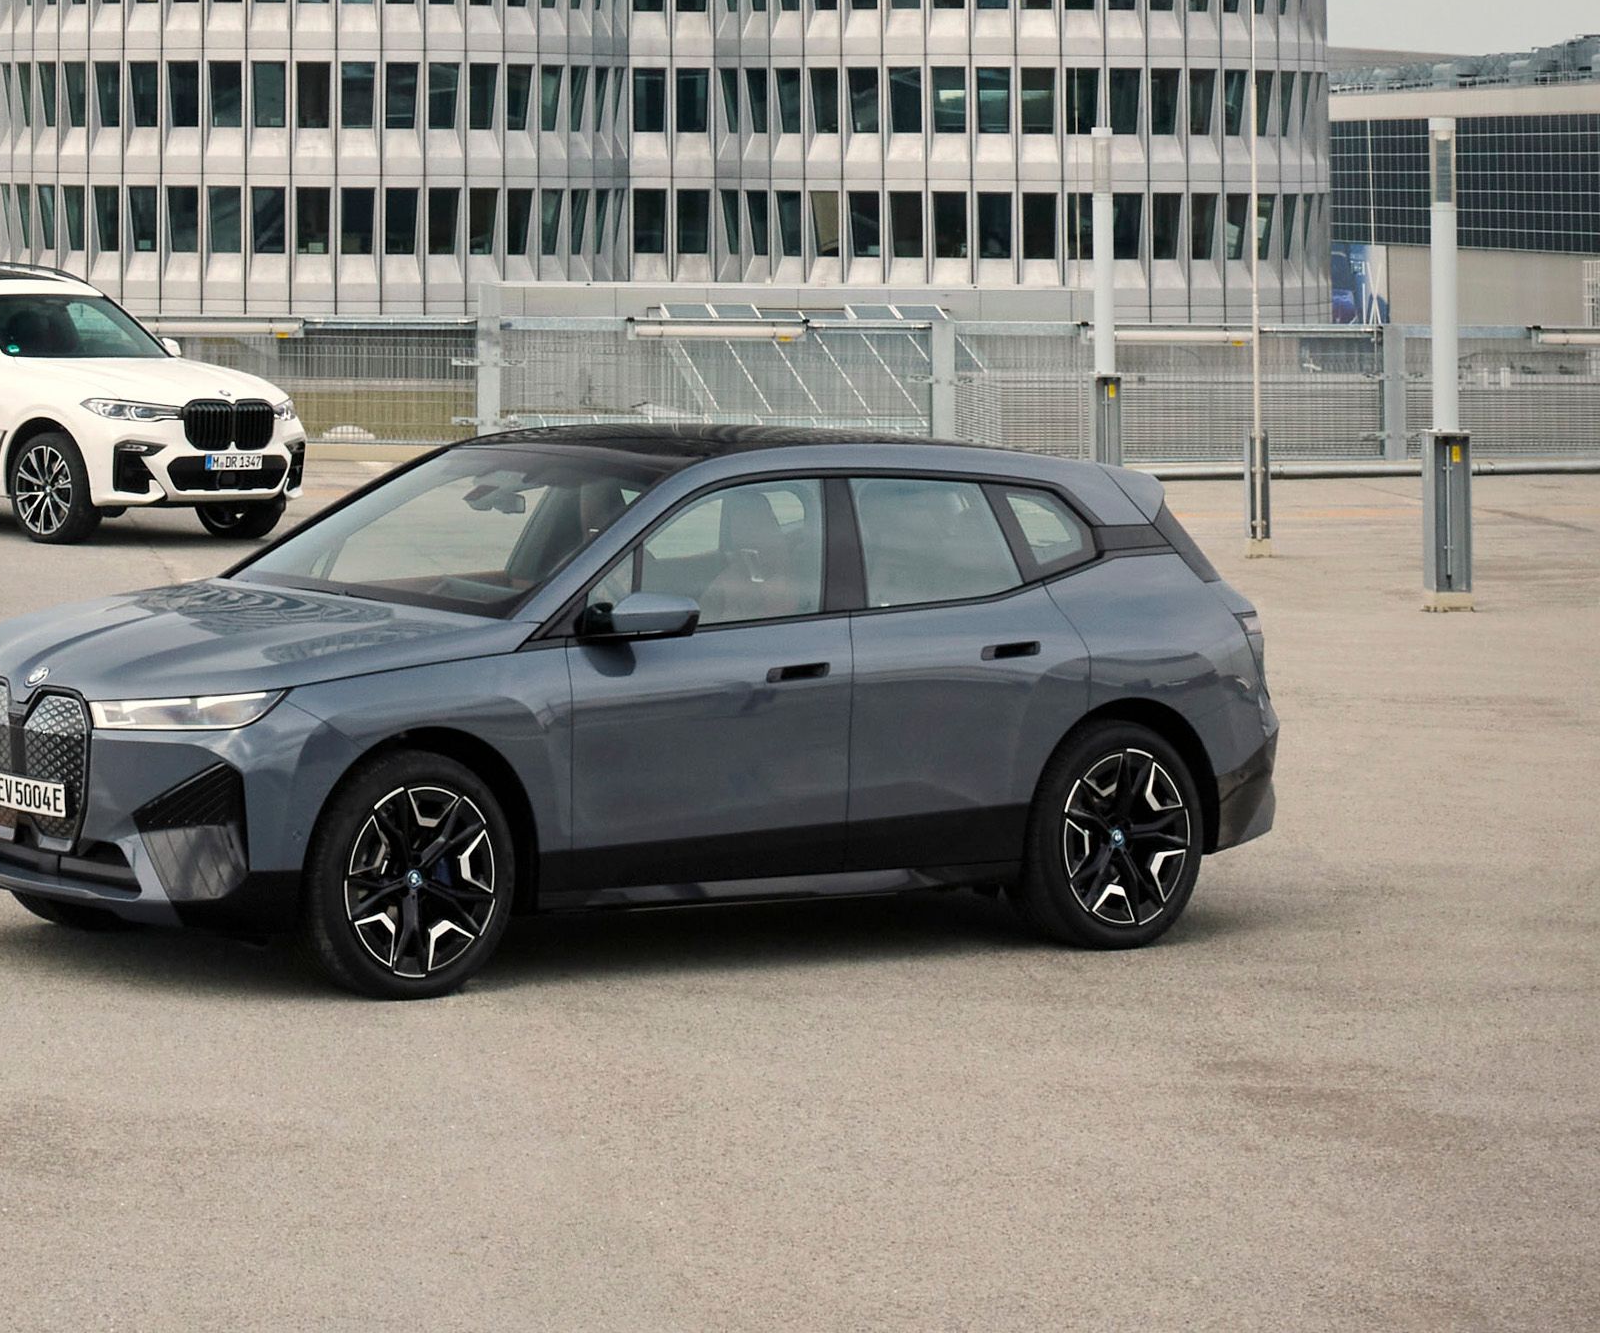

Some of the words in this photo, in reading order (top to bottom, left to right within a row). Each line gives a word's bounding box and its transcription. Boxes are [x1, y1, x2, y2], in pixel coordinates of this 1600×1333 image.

[212, 456, 220, 468] M
[225, 456, 238, 468] DR
[239, 455, 261, 468] 1347
